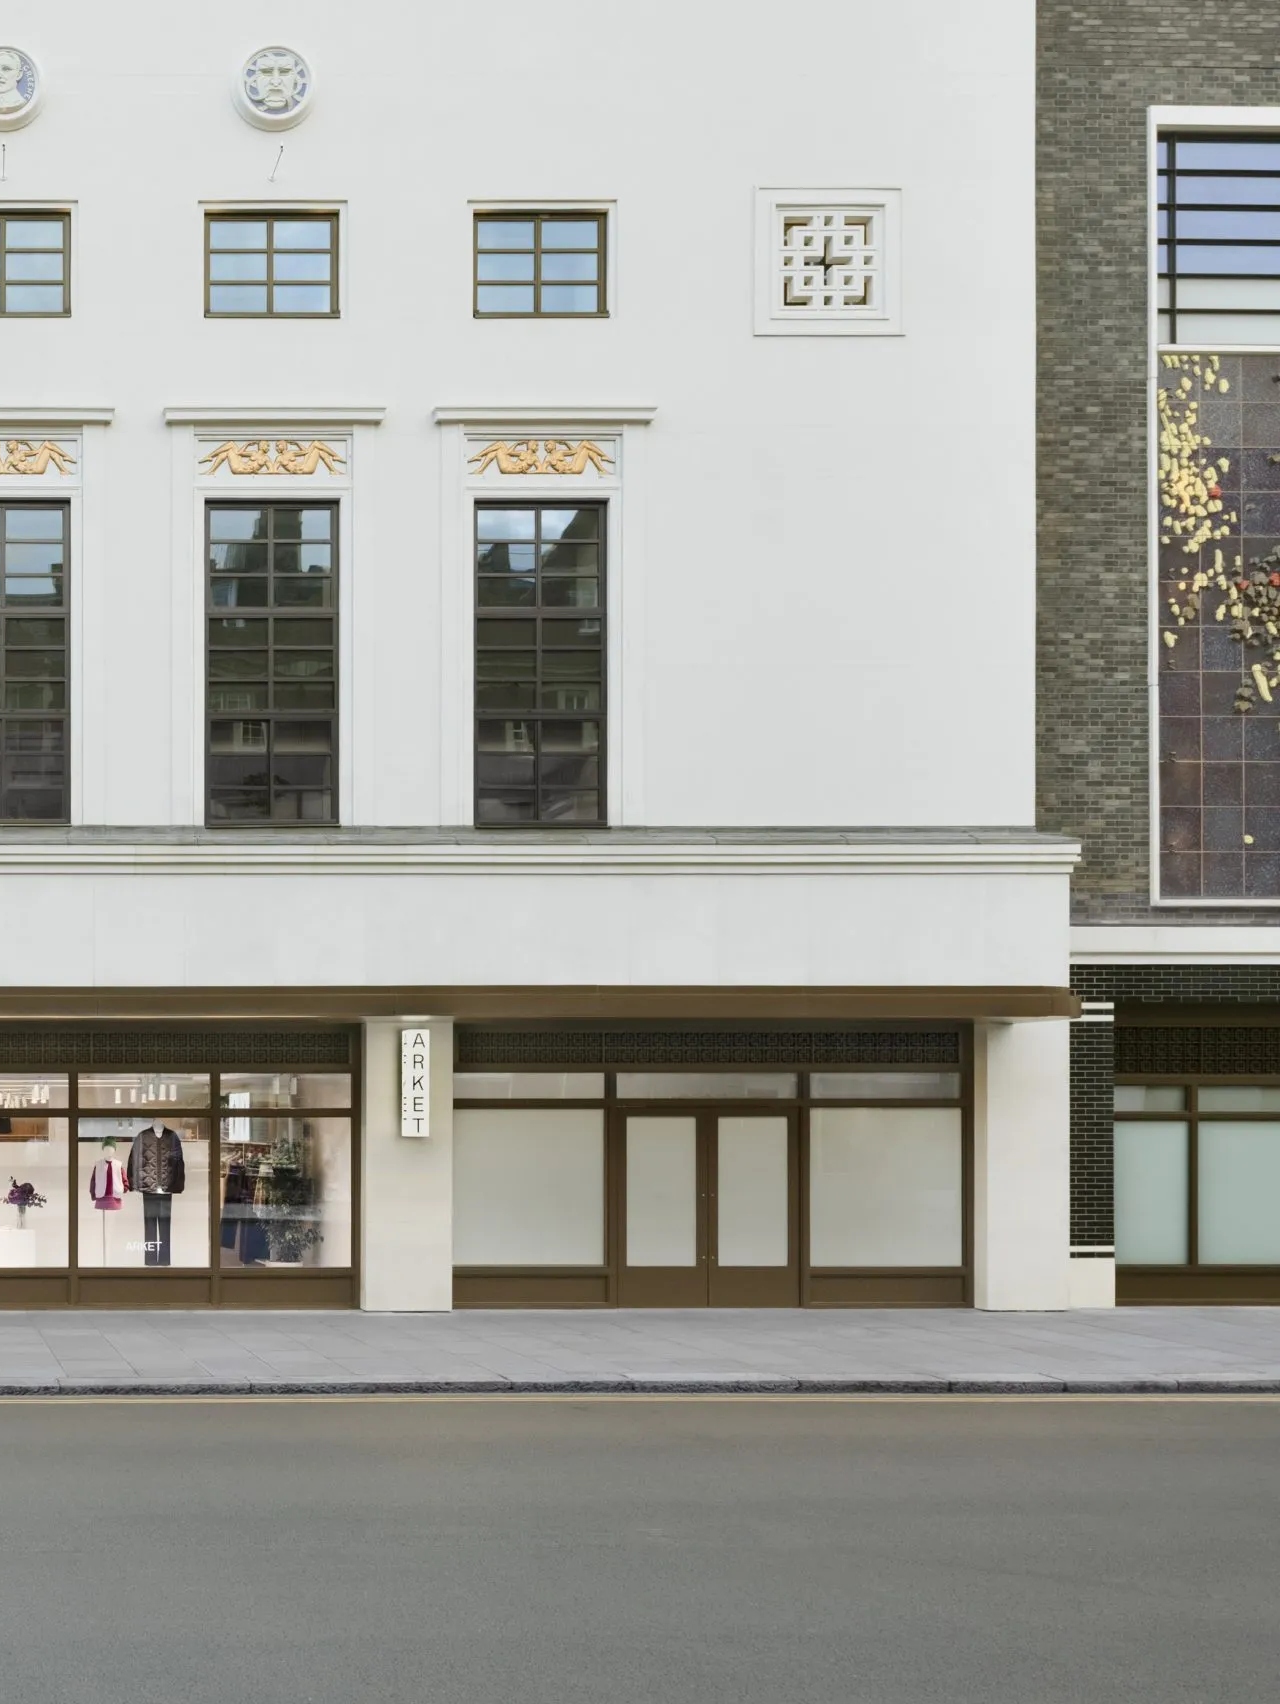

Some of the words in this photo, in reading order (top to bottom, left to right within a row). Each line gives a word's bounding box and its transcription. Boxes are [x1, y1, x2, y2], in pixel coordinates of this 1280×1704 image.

[23, 65, 34, 100] GREENE
[412, 1032, 426, 1133] ARKET
[125, 1241, 163, 1252] ARKET
